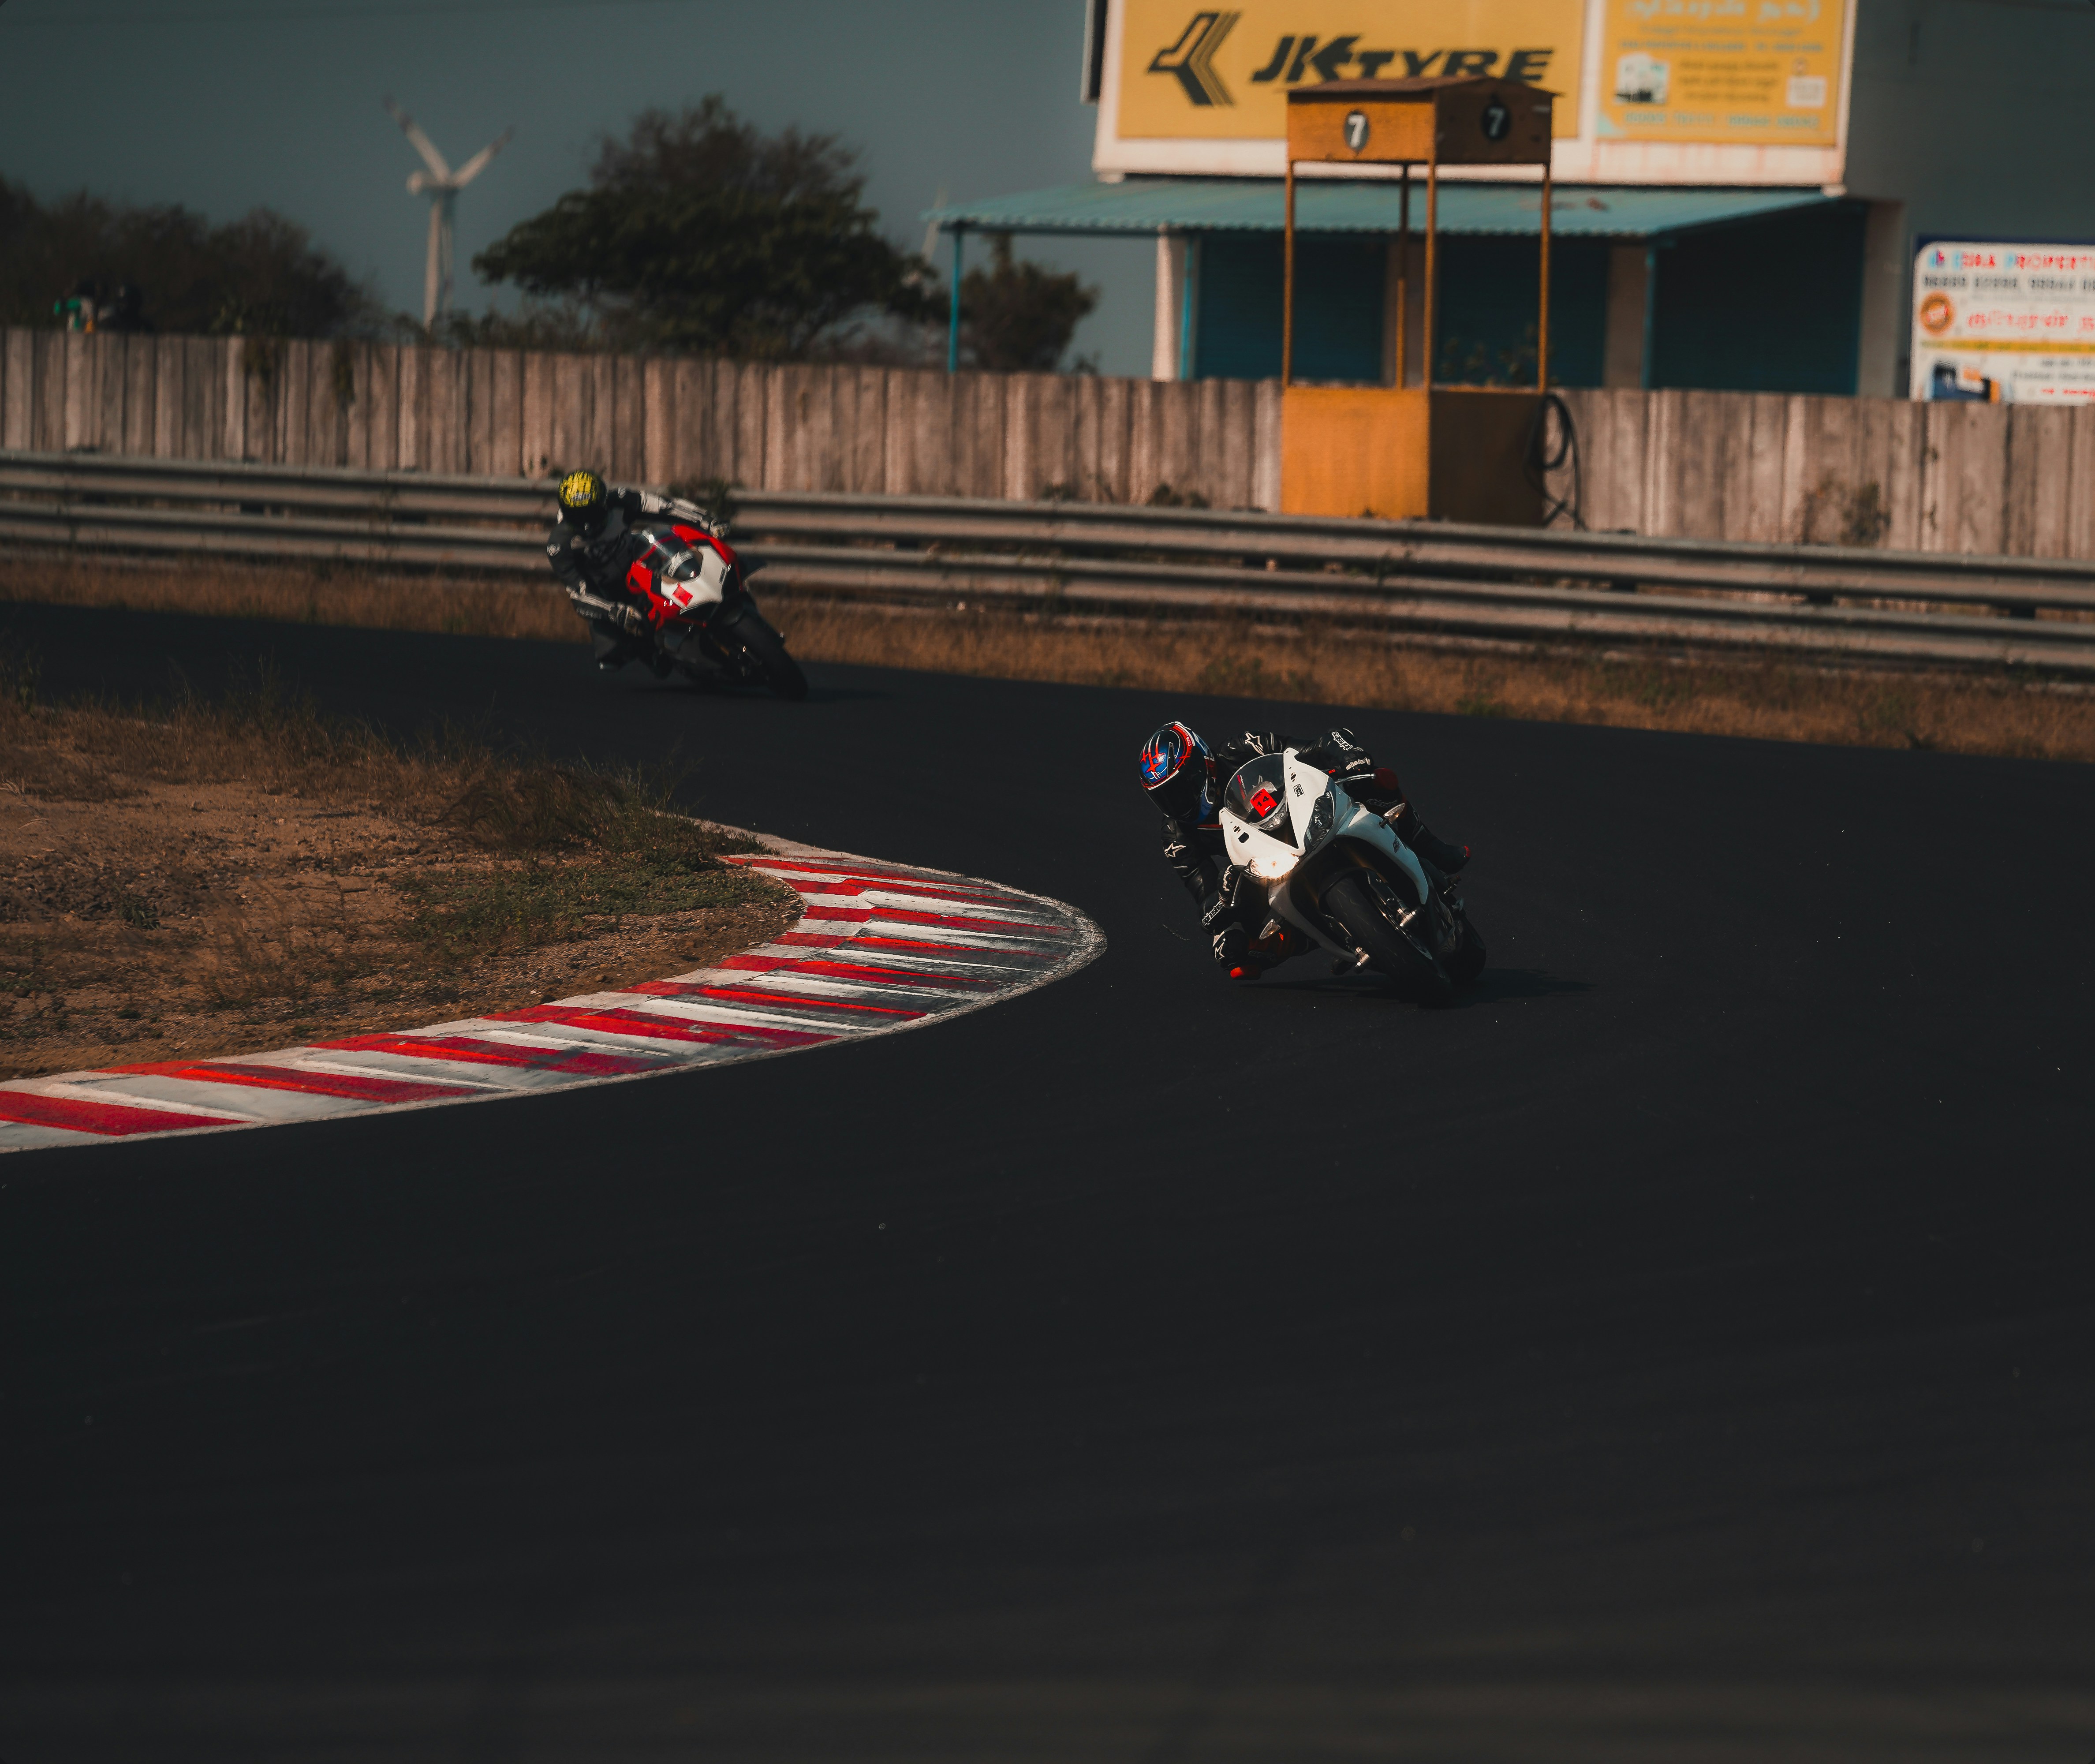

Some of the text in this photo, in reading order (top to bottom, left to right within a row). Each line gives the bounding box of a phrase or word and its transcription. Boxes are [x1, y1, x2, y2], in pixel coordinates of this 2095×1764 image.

[1347, 113, 1366, 149] 7
[1489, 106, 1505, 137] 7
[1257, 796, 1270, 807] 14
